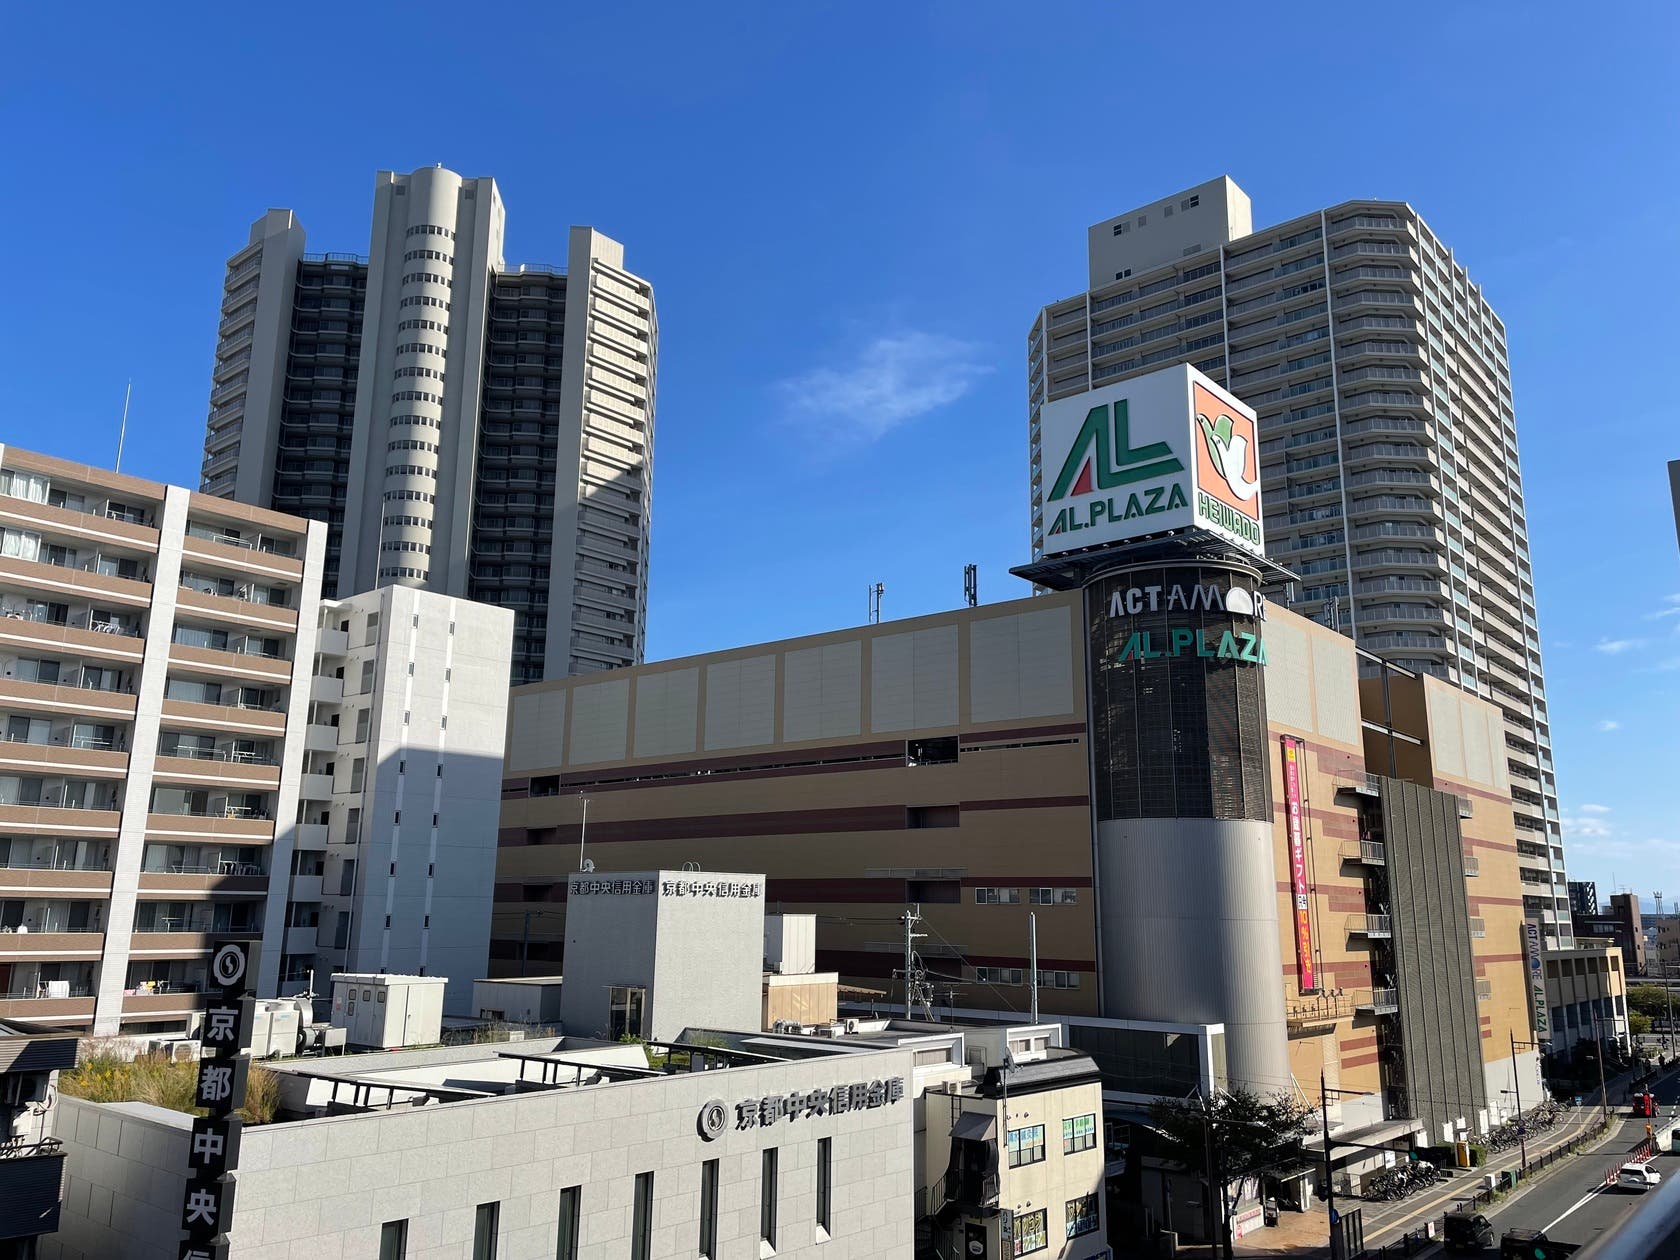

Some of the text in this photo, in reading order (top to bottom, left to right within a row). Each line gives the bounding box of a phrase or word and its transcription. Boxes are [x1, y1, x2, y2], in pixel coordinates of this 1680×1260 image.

[1048, 483, 1189, 536] AL.PLAZA
[1198, 491, 1261, 546] HEIWADO
[1119, 628, 1269, 667] AL.PLAZA
[570, 880, 654, 896] 京都中央信用金庫
[663, 881, 762, 898] 京都中央信用金庫
[1533, 984, 1547, 1033] AL.PLAZA
[738, 1076, 904, 1129] 京都中央信用金庫
